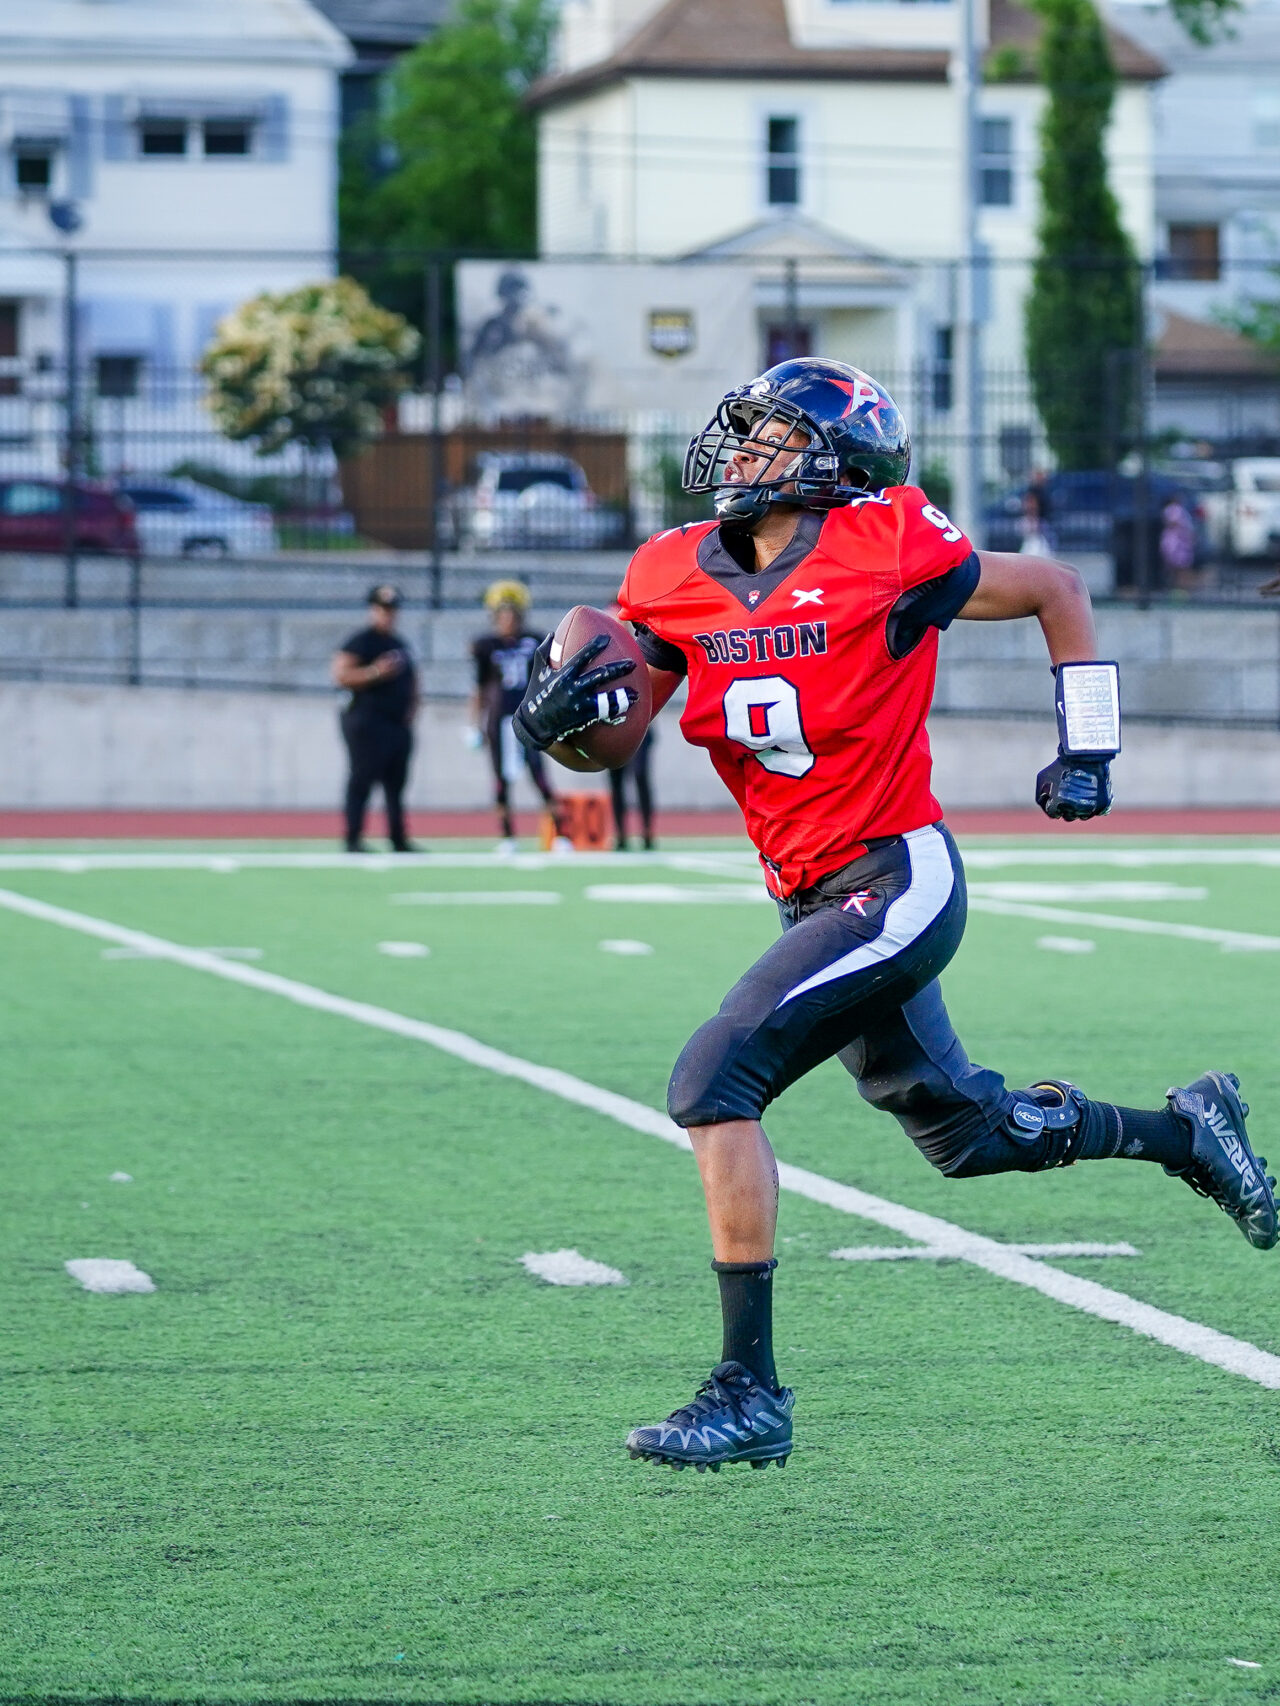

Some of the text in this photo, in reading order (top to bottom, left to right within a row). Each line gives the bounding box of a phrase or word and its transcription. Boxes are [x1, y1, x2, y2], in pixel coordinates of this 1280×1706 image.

[920, 503, 963, 543] 9
[692, 621, 828, 664] BOSTON
[722, 673, 817, 780] 9
